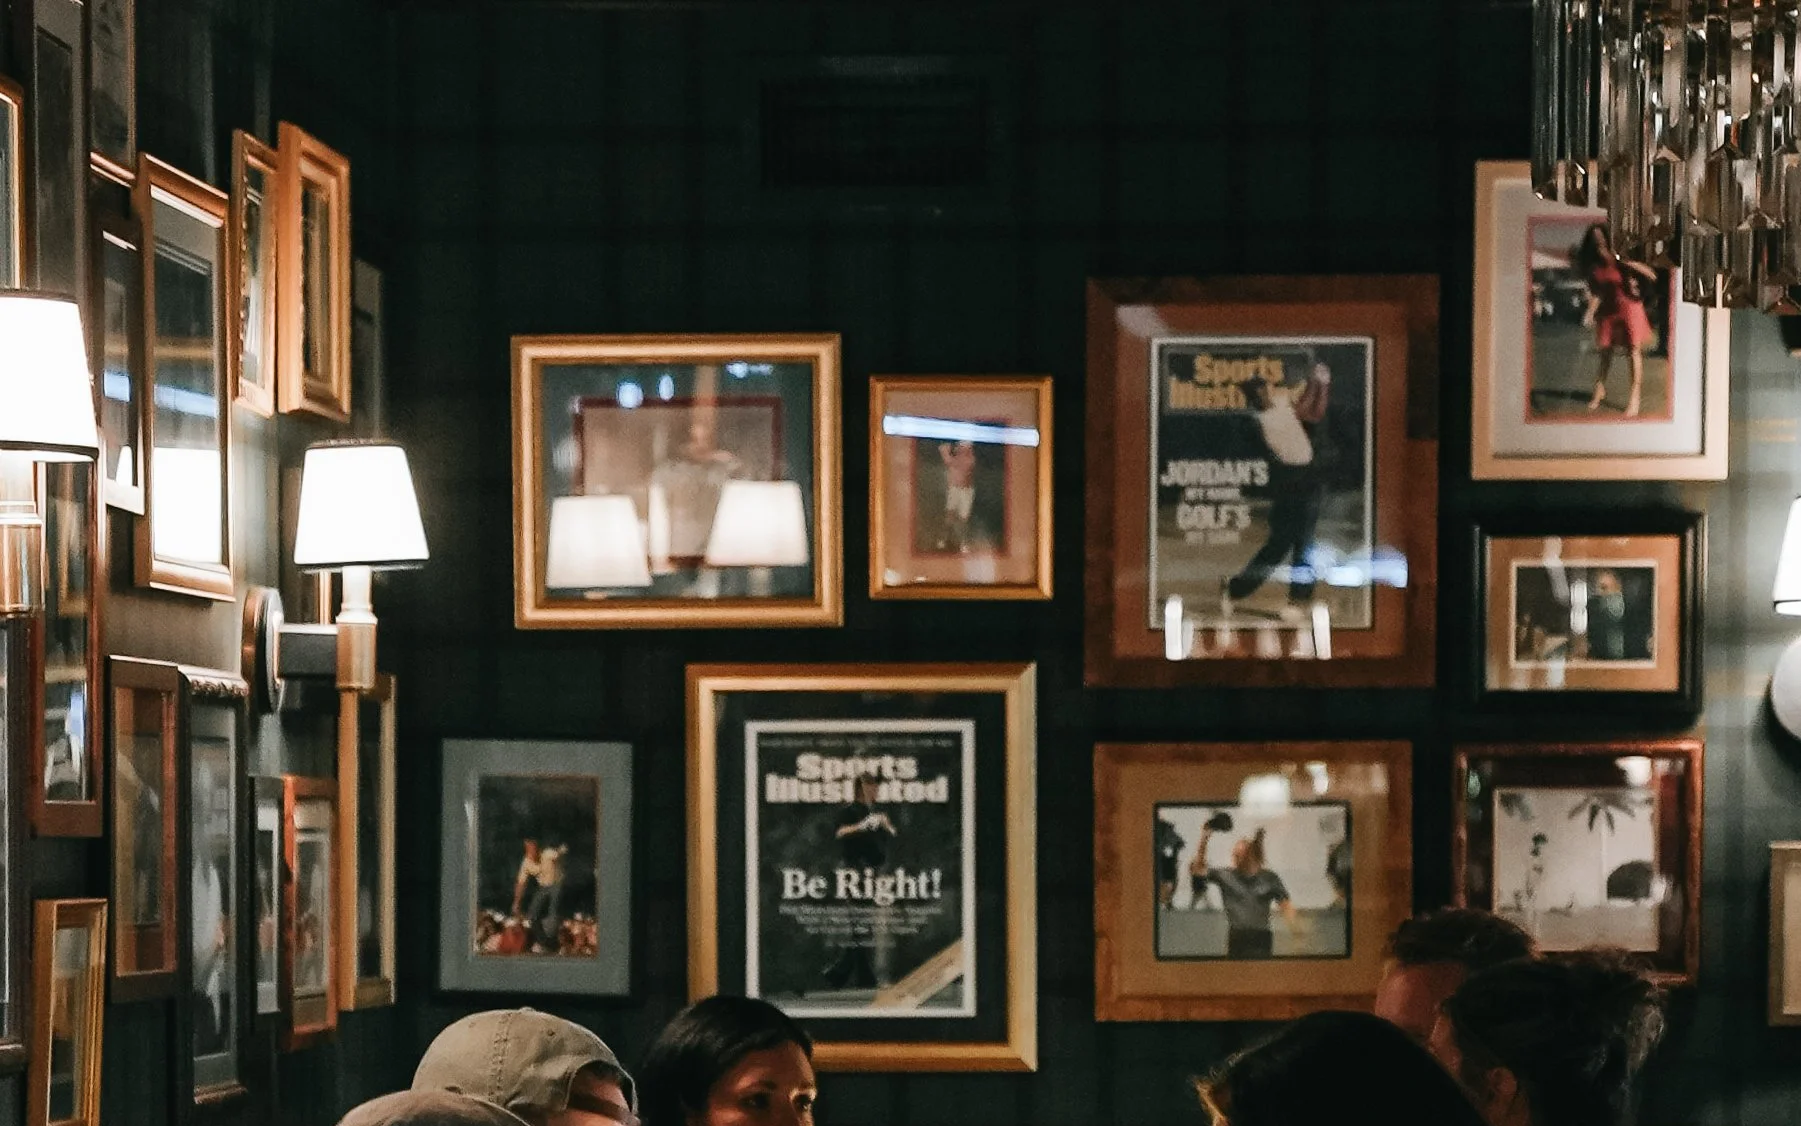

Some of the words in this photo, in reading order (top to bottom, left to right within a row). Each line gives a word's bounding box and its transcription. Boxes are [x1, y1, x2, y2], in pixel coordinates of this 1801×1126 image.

[1194, 352, 1284, 385] Sports
[1160, 459, 1269, 486] JORDAN'S
[796, 753, 919, 782] Sports
[765, 773, 949, 803] Illustated
[781, 867, 827, 900] Be
[835, 867, 943, 906] Right!
